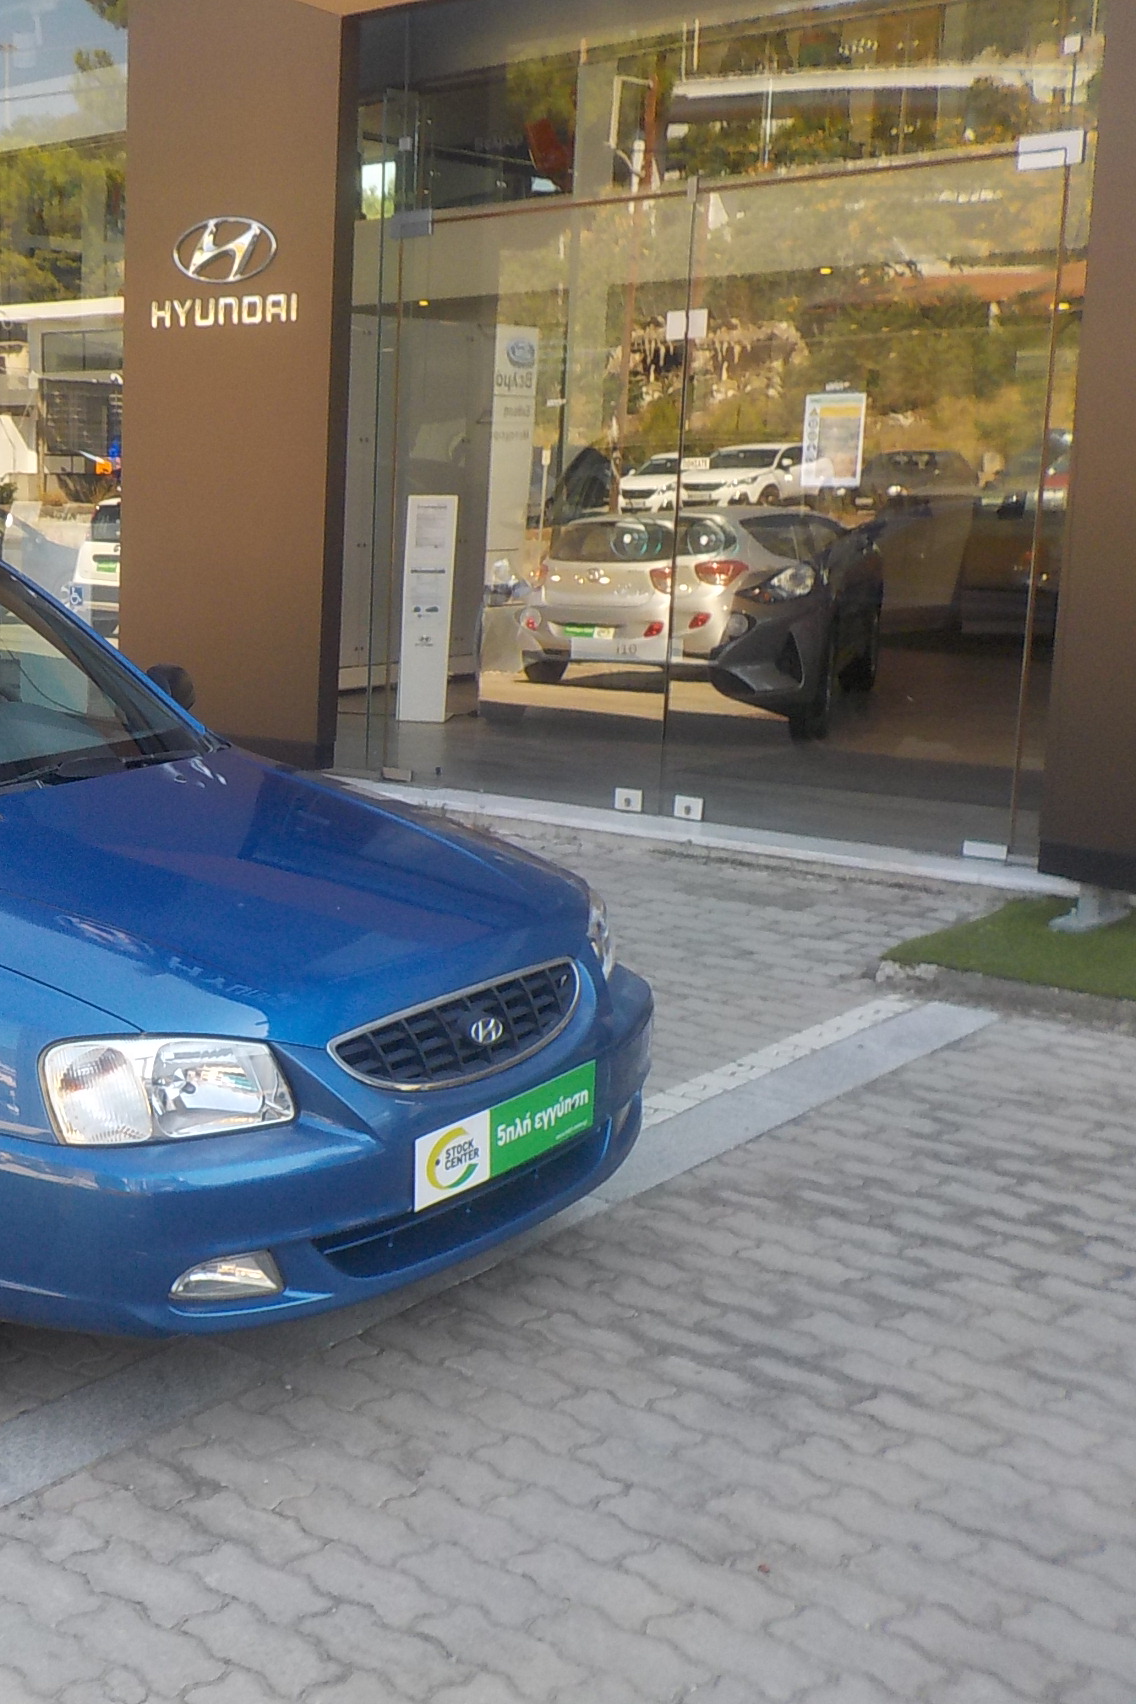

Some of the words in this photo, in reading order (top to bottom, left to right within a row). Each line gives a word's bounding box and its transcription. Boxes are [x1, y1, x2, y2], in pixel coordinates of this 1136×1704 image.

[150, 292, 298, 329] HYUNDAI
[444, 1147, 480, 1171] CENTER
[445, 1138, 474, 1160] STOCK
